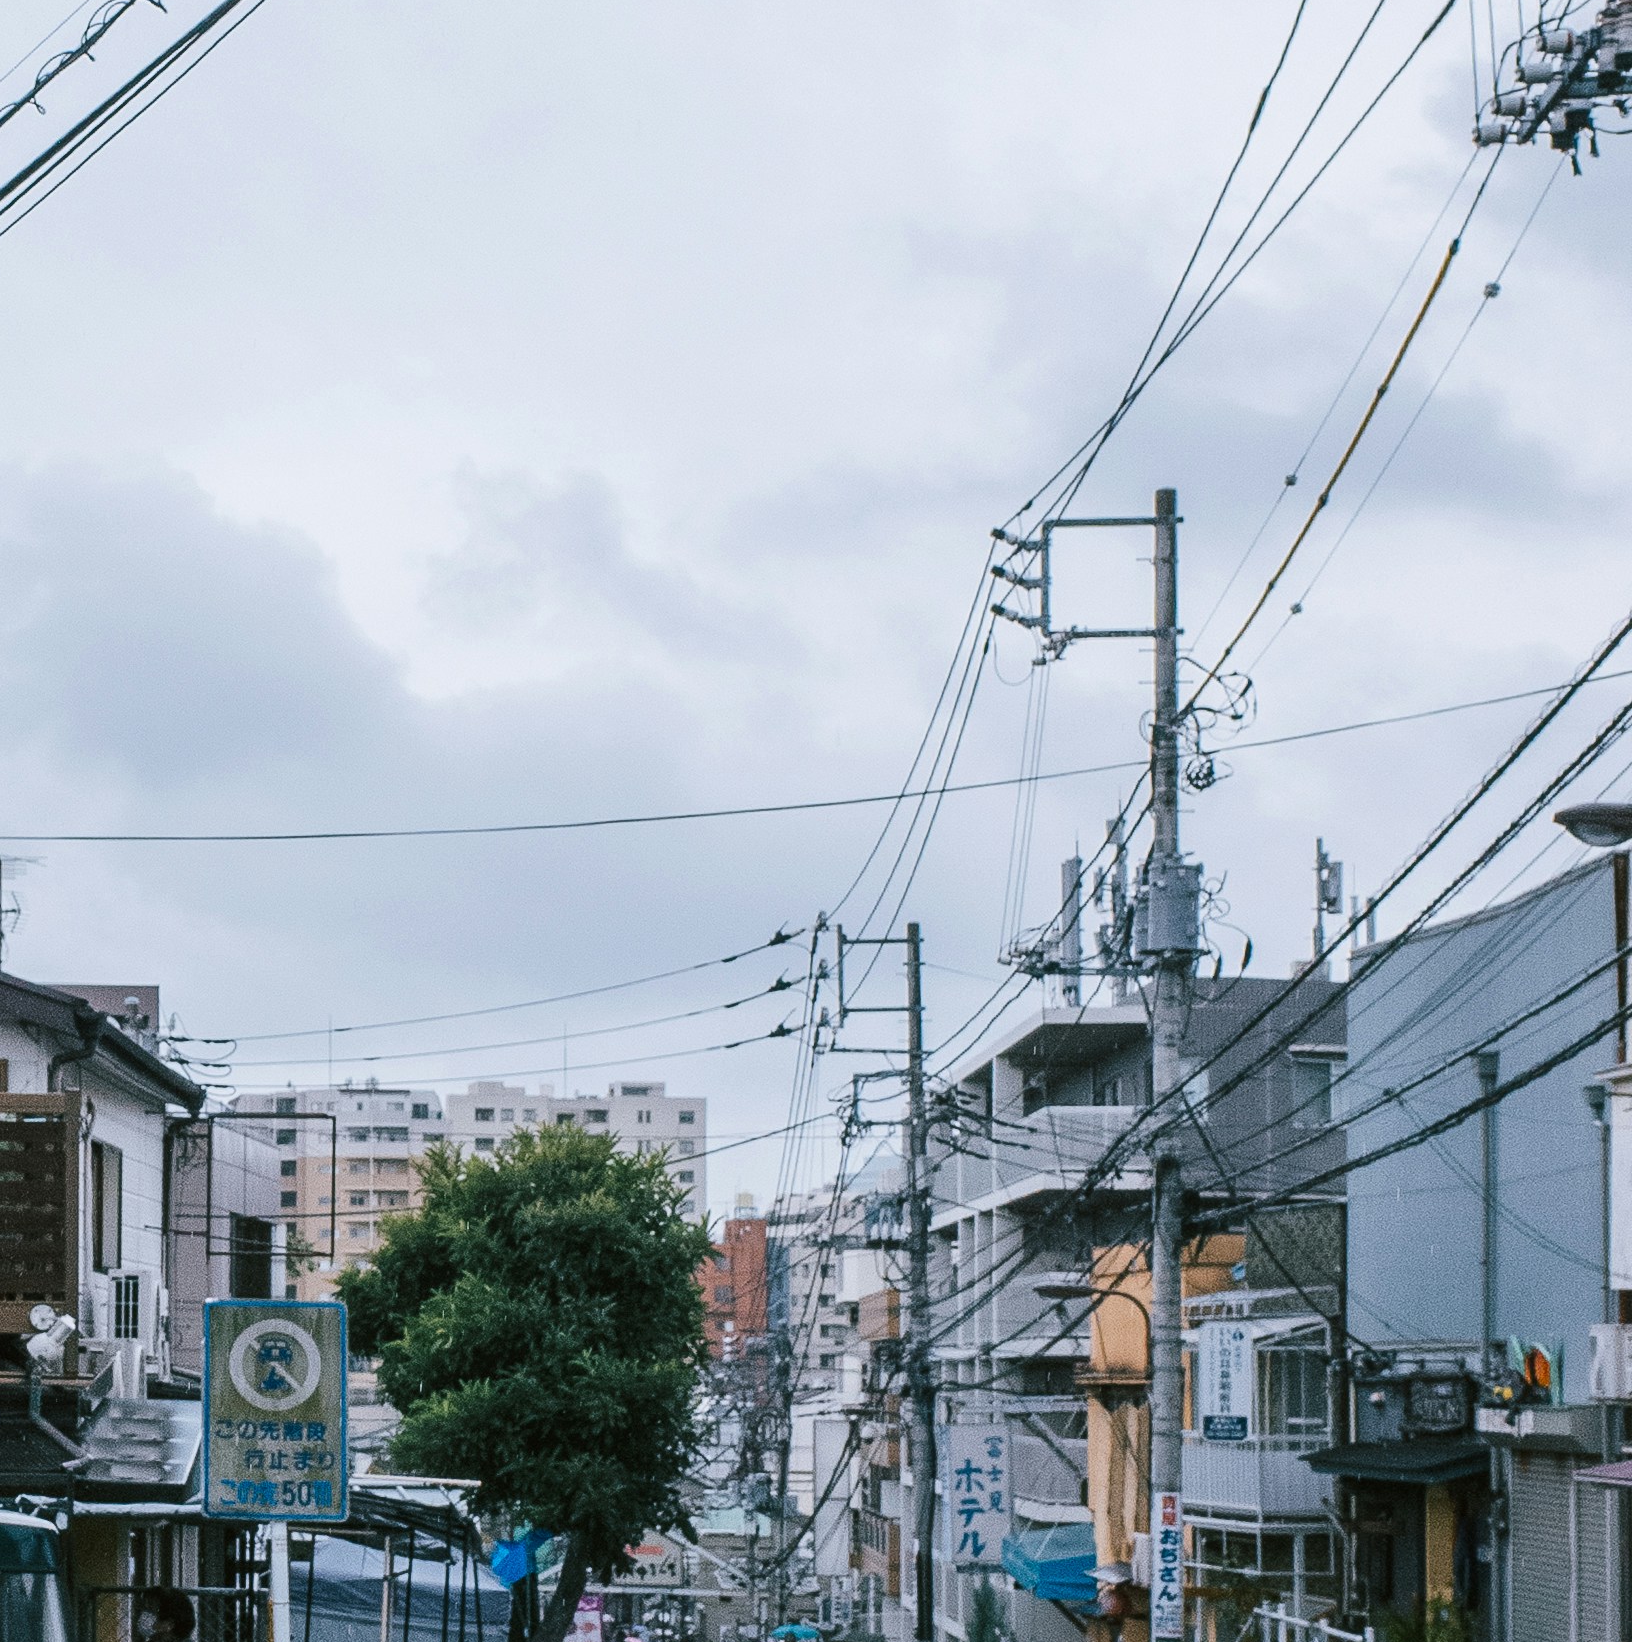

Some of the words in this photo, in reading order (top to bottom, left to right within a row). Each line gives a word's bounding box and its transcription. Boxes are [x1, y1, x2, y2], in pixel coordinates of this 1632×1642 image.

[216, 1419, 327, 1441] この先階段
[245, 1448, 335, 1471] 行止まり
[954, 1458, 987, 1558] ホテル
